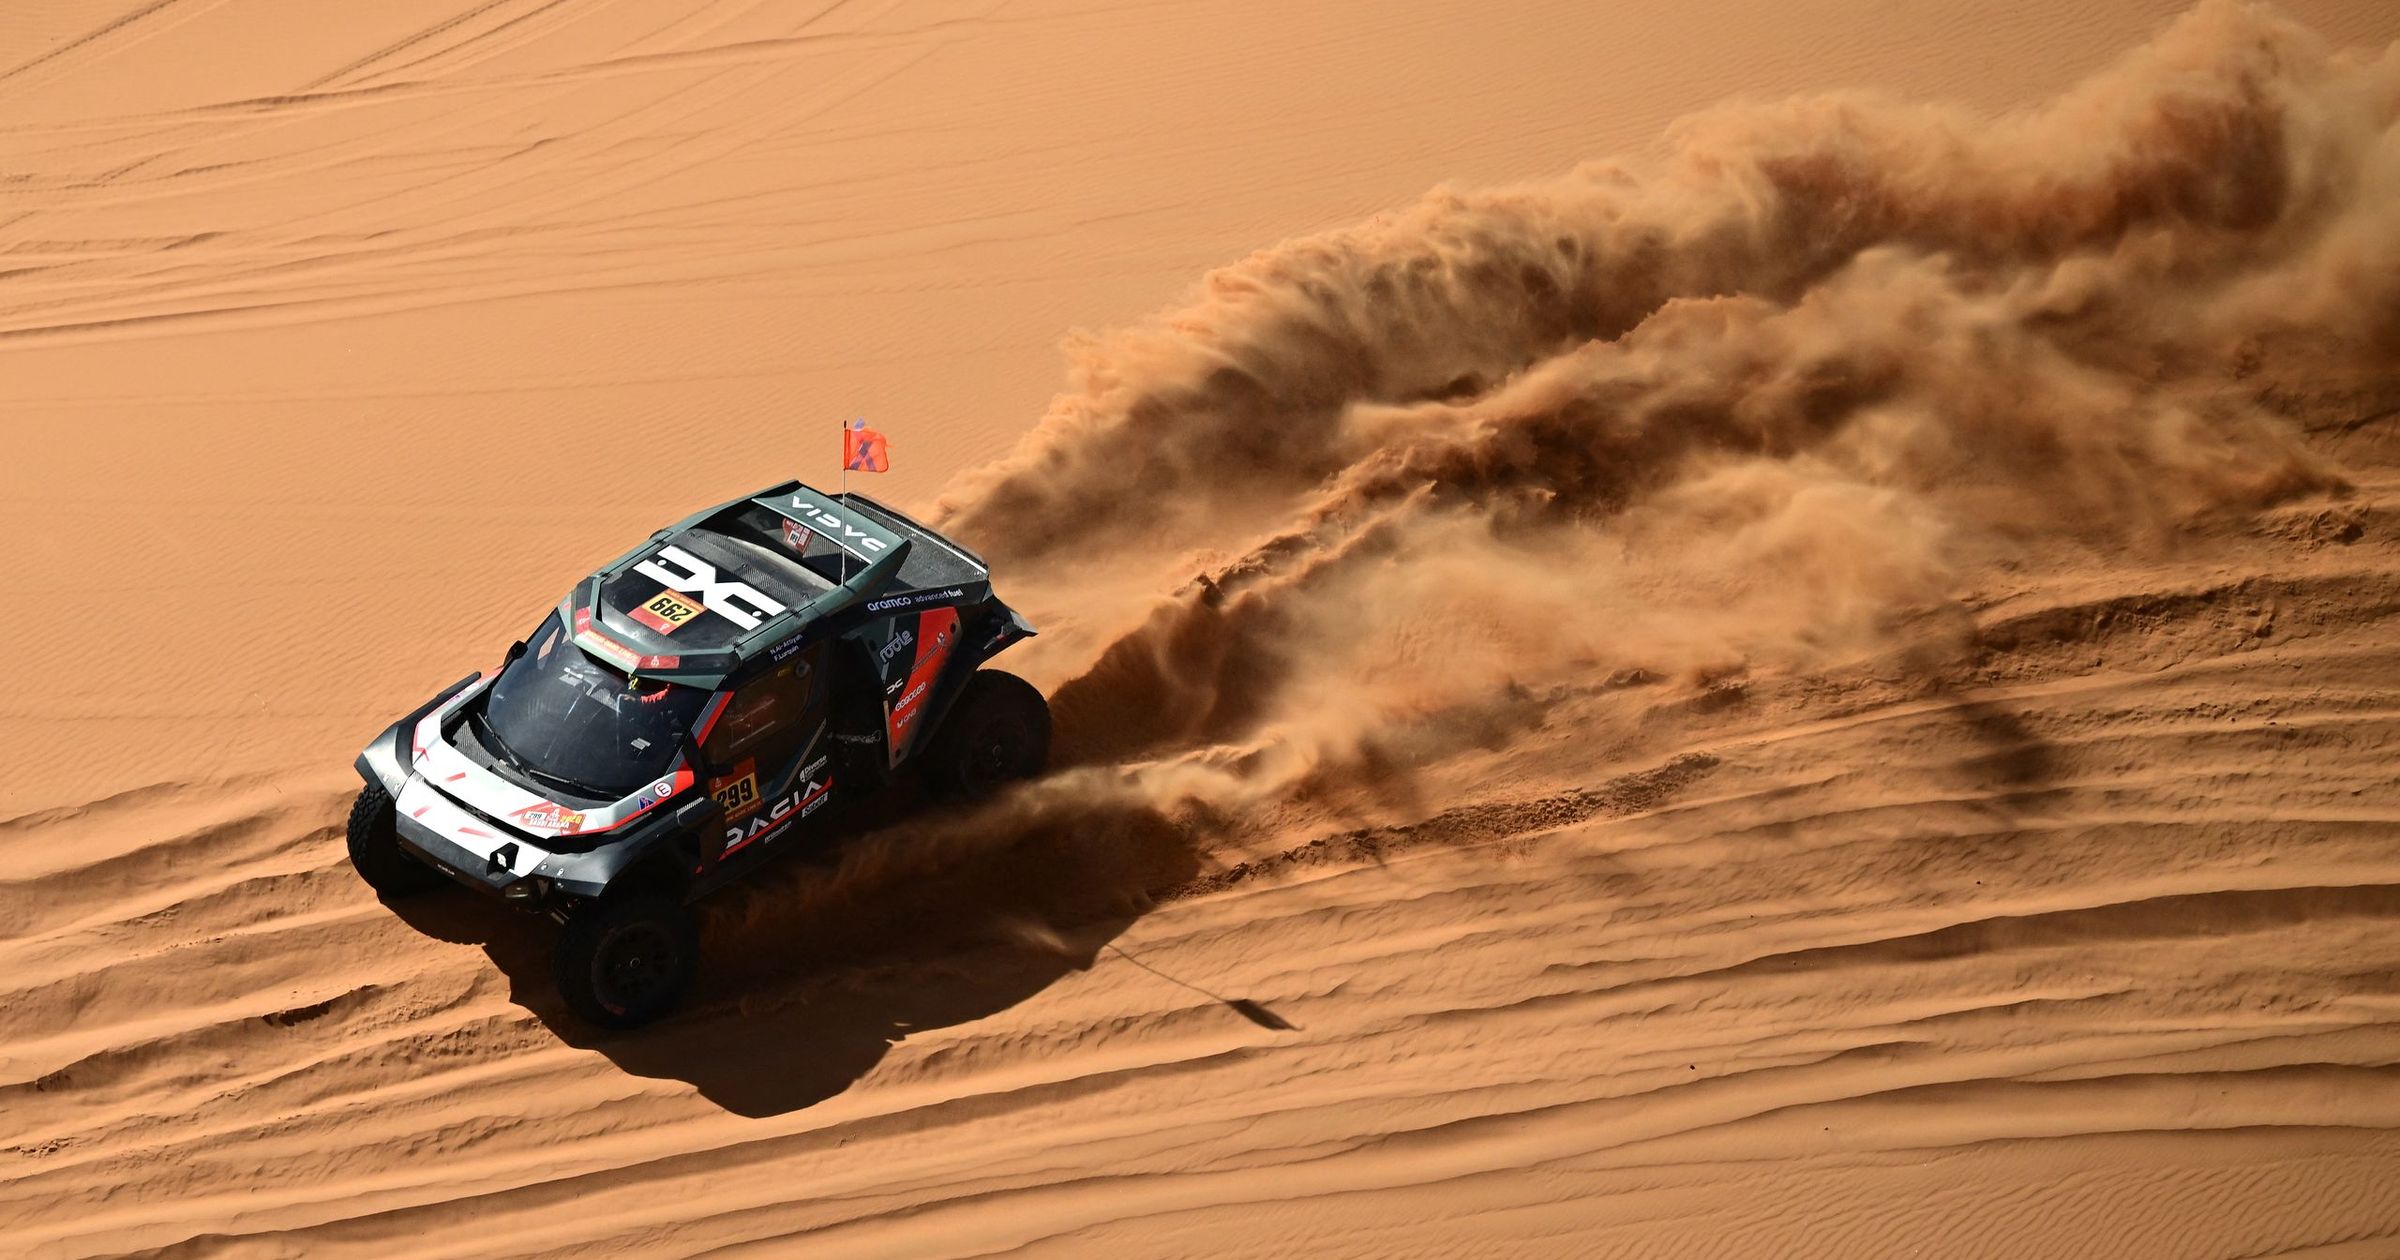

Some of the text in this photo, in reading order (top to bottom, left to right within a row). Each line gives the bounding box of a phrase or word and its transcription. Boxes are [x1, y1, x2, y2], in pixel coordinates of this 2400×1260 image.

[792, 495, 887, 551] DACIA
[649, 597, 693, 621] 299
[867, 596, 911, 612] aramco
[948, 588, 963, 599] fuel
[725, 780, 823, 849] DACIA
